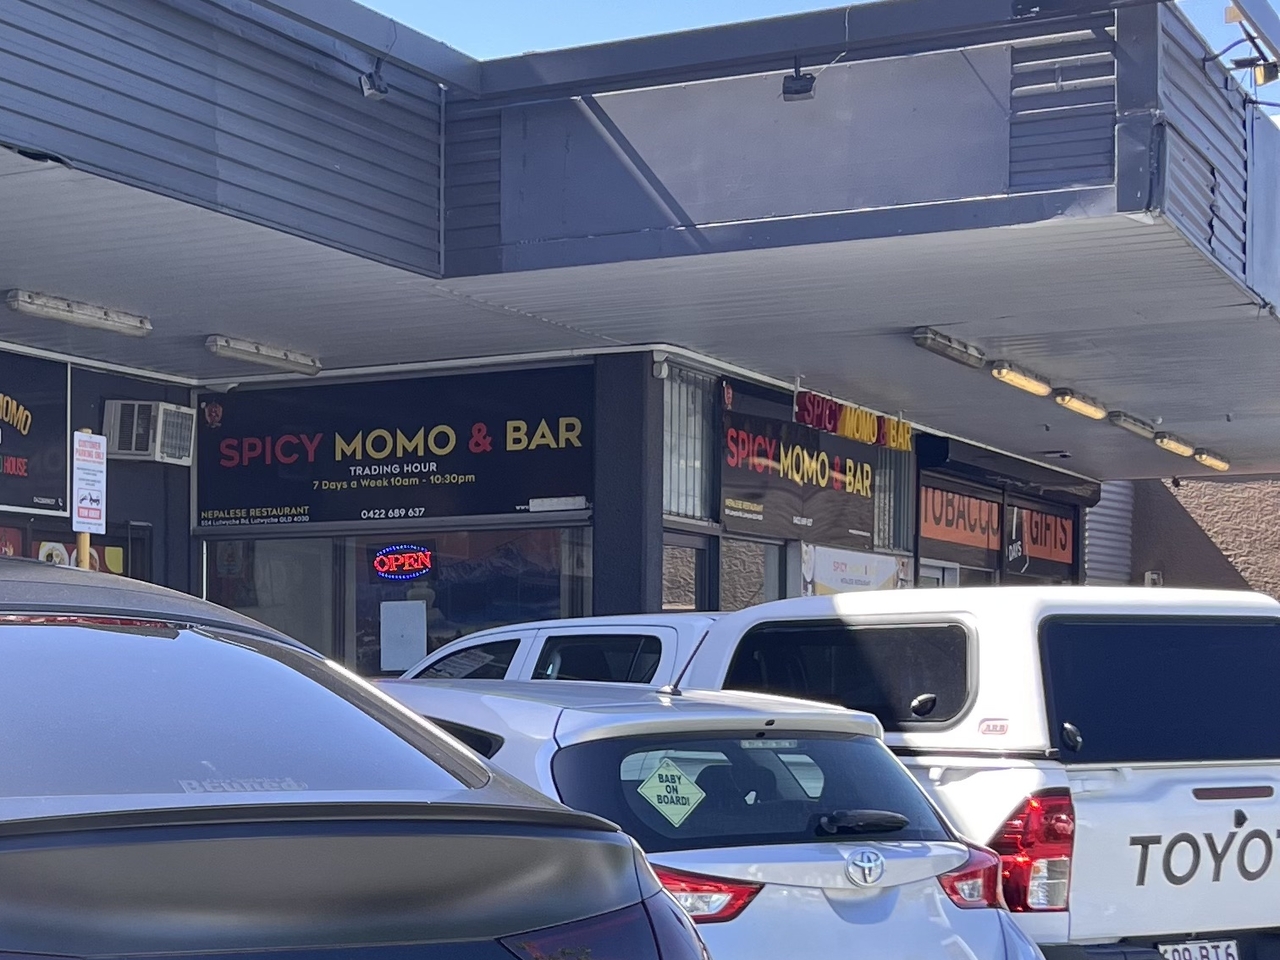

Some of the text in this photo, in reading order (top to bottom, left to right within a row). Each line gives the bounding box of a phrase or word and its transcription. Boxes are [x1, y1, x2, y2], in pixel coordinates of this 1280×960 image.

[844, 405, 878, 444] MOMO
[889, 417, 912, 452] BAR
[219, 416, 583, 468] SPICY MOMO & BAR
[3, 456, 28, 477] HOUSE
[349, 462, 437, 476] TRADING HOUR
[727, 427, 873, 499] SPICY MOMO & BAR
[313, 481, 320, 490] 7
[322, 480, 348, 491] Days
[350, 480, 357, 488] a
[360, 478, 389, 488] Week
[391, 476, 419, 486] 10am
[429, 474, 476, 486] 10:30pm
[201, 505, 310, 519] NEPALESE RESTAURANT
[361, 507, 426, 520] 0422 689 637
[923, 487, 1000, 537] TOBACCO
[1029, 511, 1068, 551] GIFTS
[373, 550, 431, 573] OPEN
[657, 773, 682, 785] BABY
[665, 784, 679, 795] ON
[1129, 828, 1280, 887] TOYO
